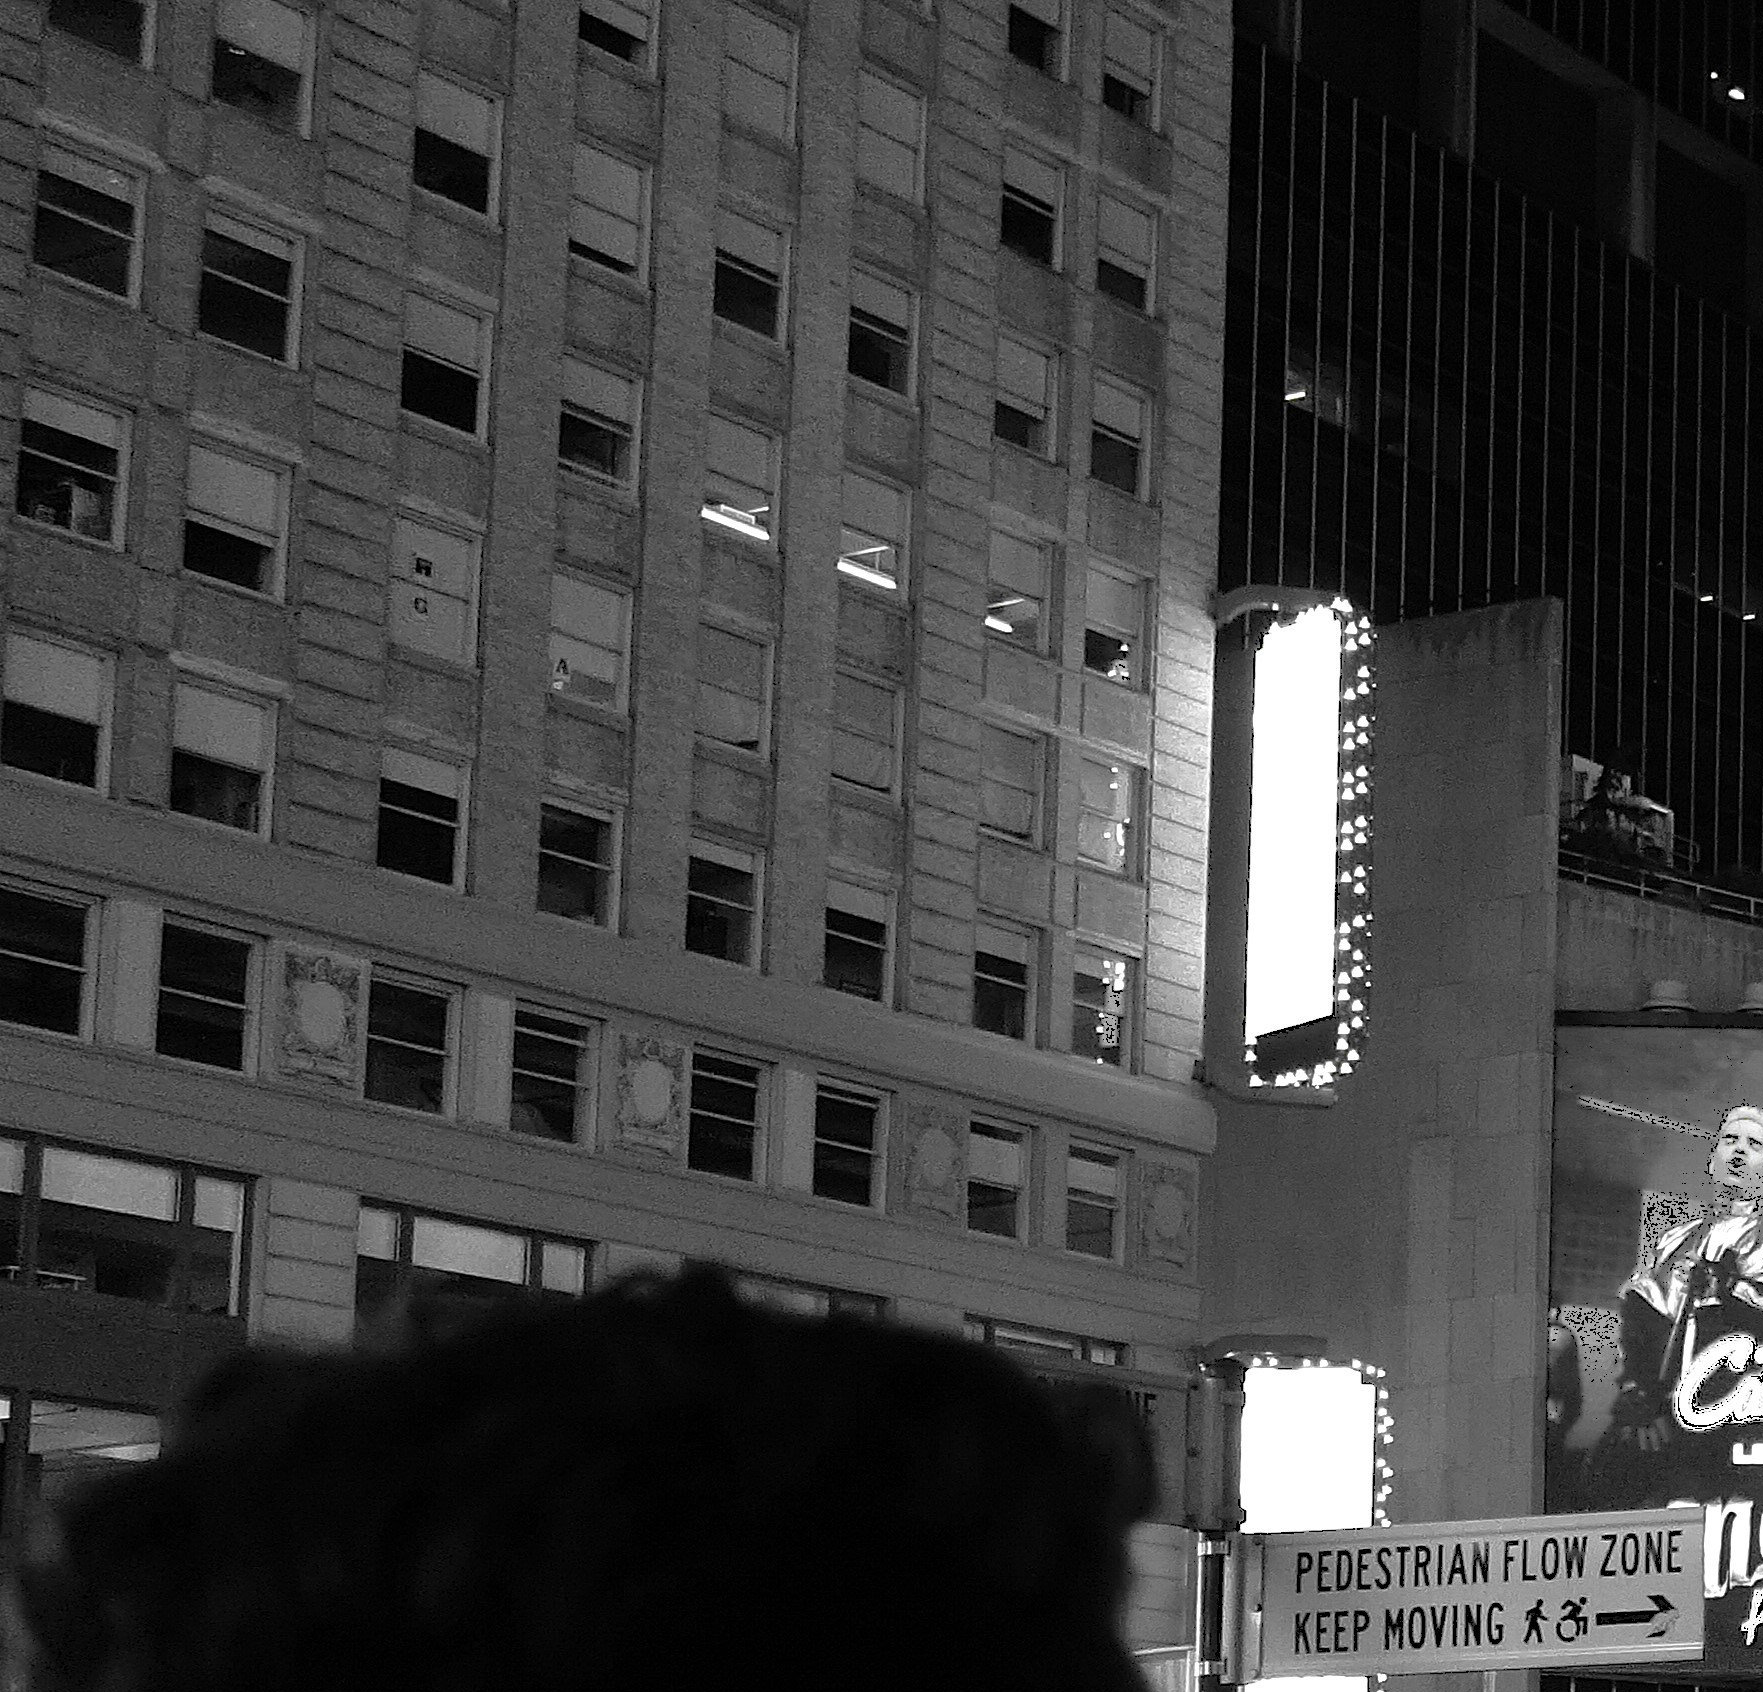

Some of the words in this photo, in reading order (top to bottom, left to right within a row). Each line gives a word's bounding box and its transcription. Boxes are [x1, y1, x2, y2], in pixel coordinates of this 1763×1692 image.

[1296, 1541, 1490, 1594] PEDESTRIAN
[1503, 1535, 1589, 1582] FLOW
[1600, 1530, 1683, 1577] ZONE
[1294, 1609, 1371, 1655] KEEP
[1384, 1602, 1505, 1651] MOVING
